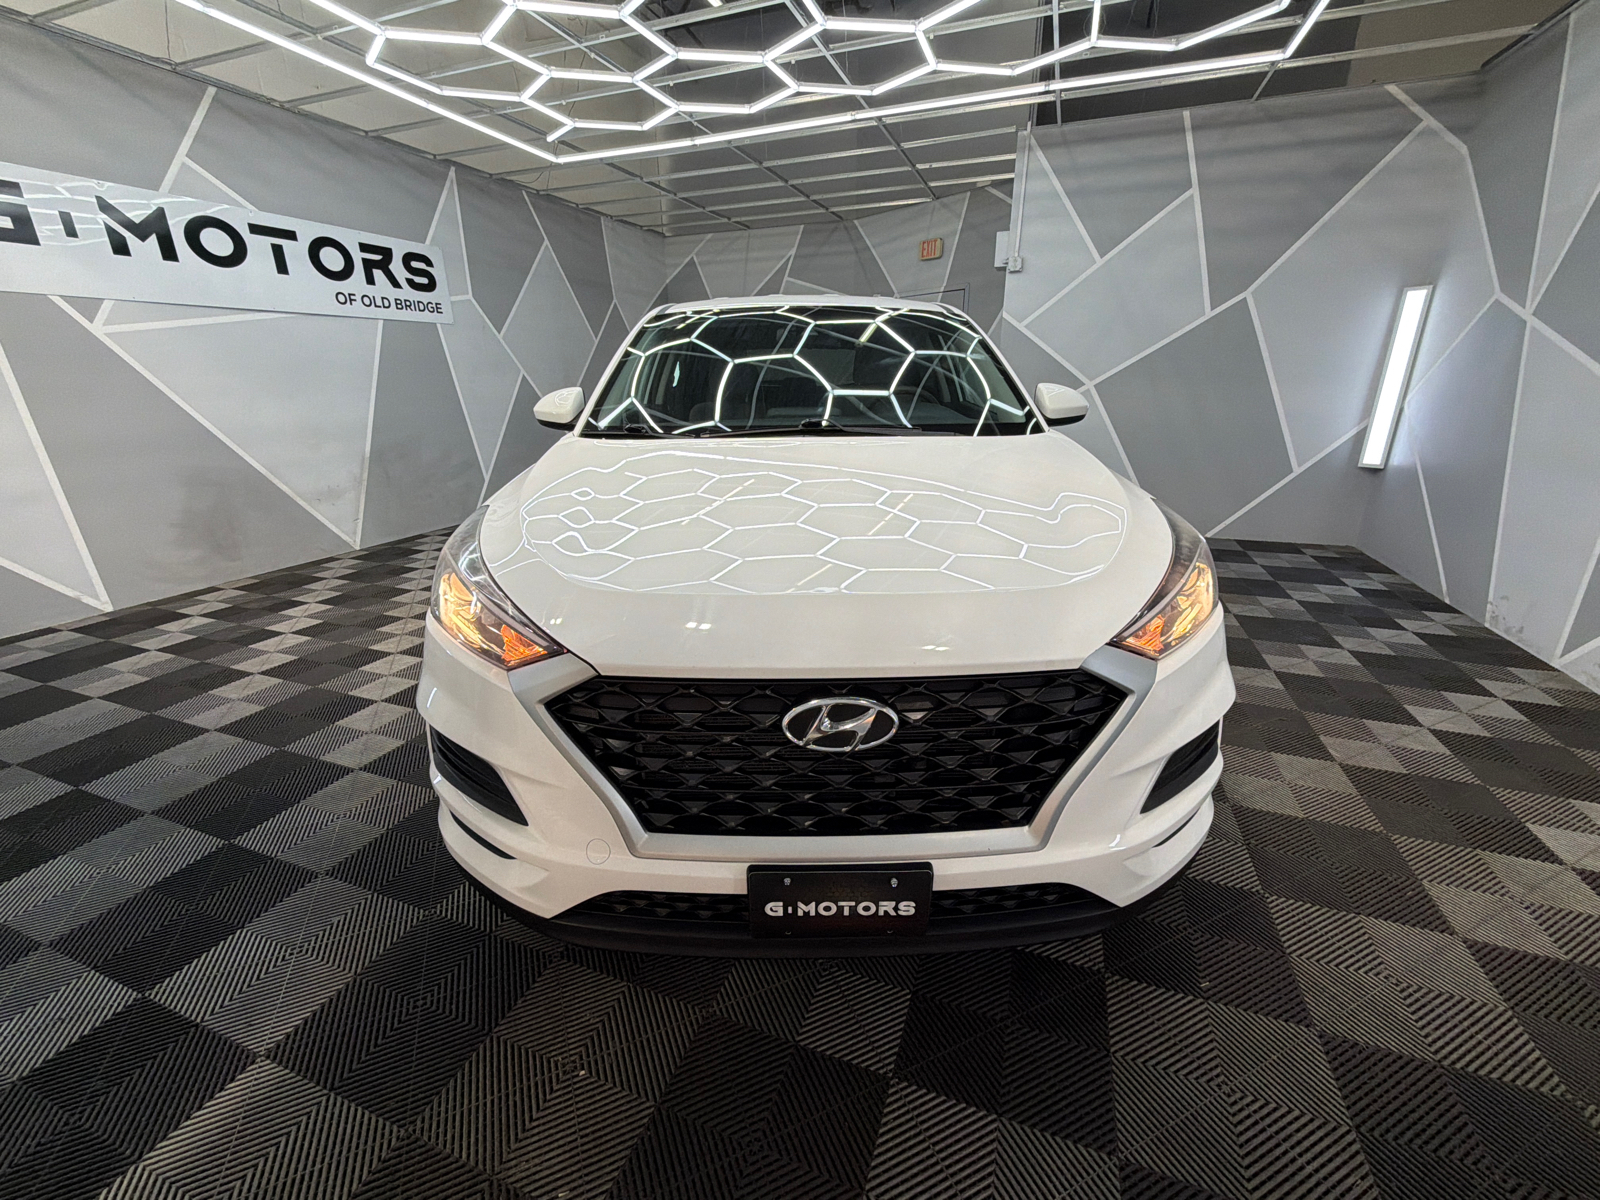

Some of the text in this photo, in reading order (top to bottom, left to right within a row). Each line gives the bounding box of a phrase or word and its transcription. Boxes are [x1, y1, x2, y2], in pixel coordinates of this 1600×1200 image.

[921, 239, 938, 258] EXIT
[335, 291, 444, 314] OF OLD BRIDGE
